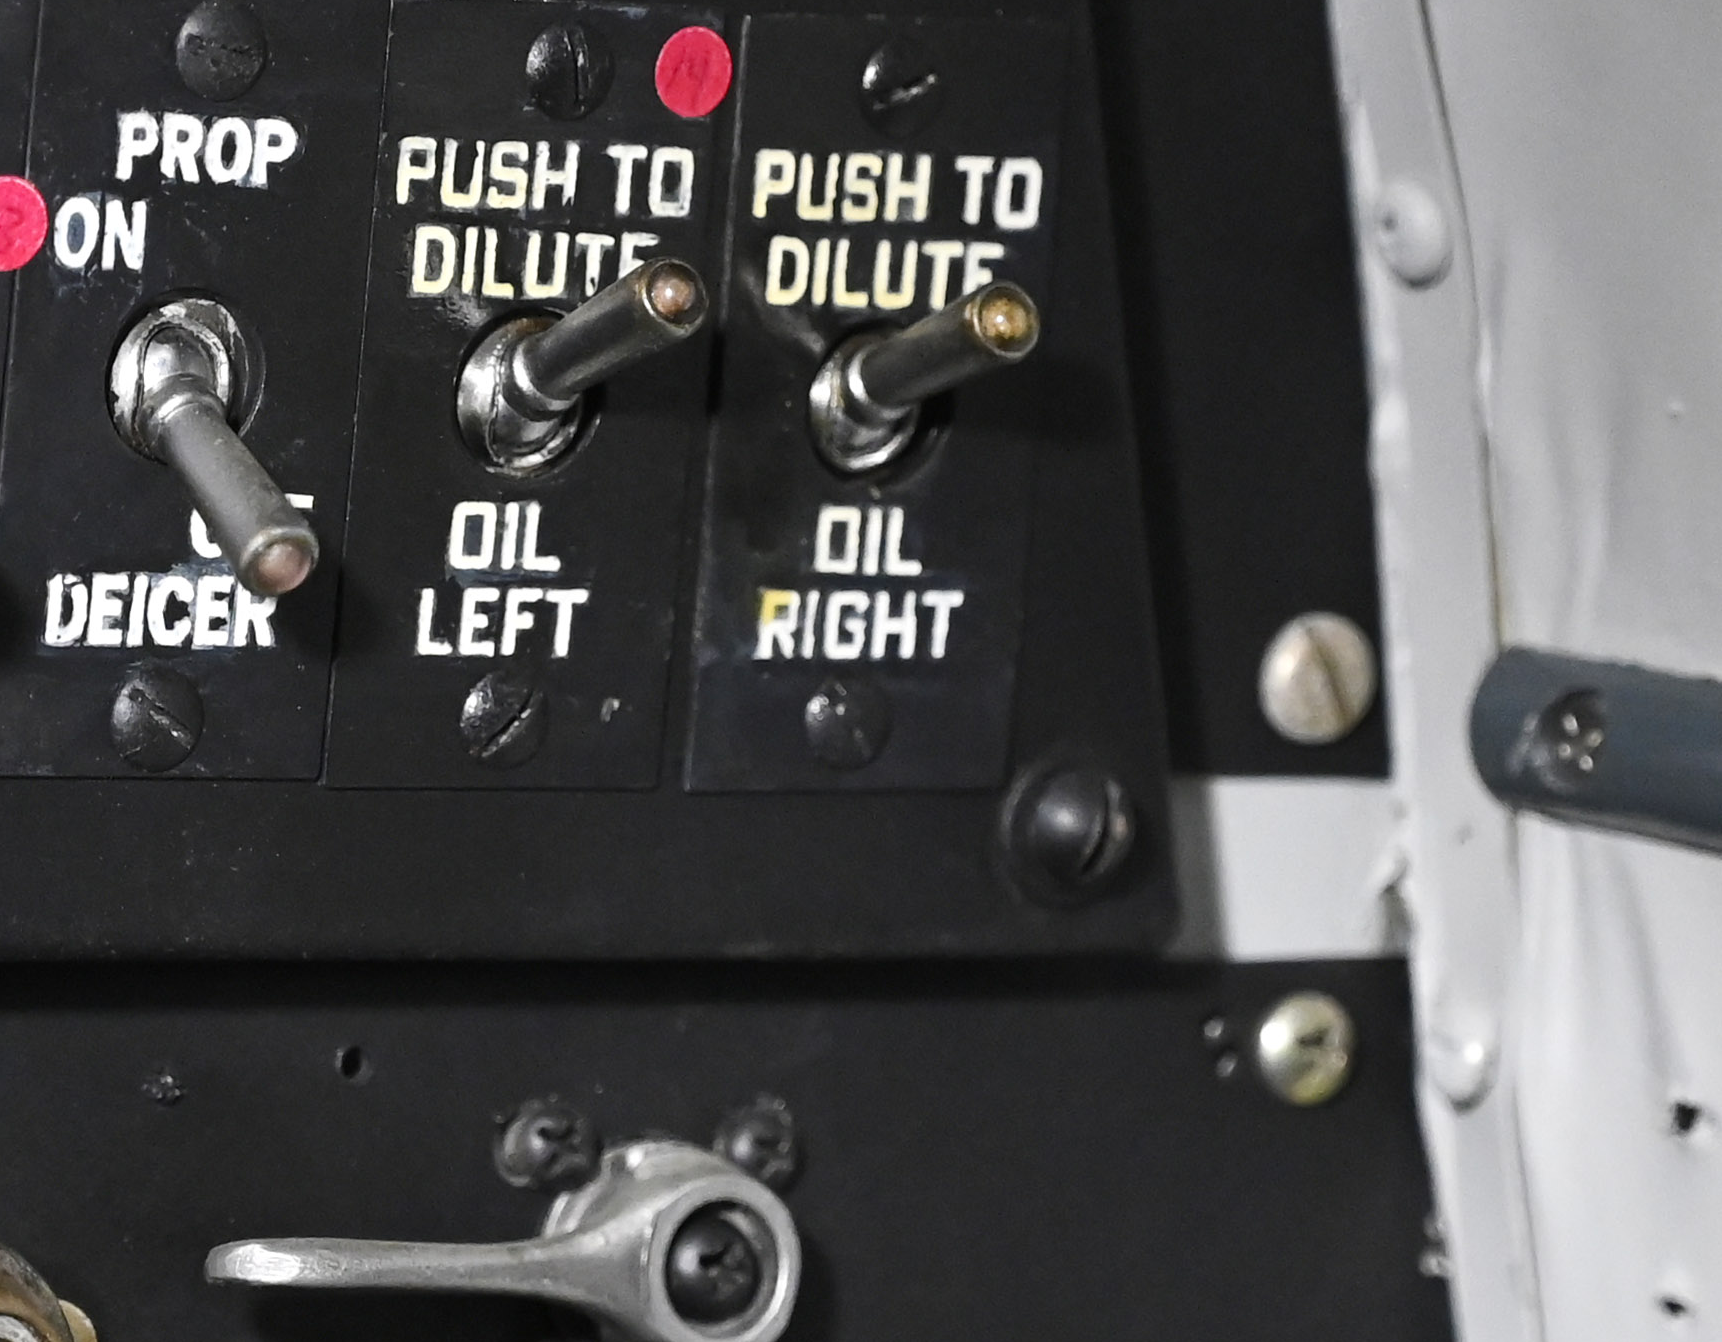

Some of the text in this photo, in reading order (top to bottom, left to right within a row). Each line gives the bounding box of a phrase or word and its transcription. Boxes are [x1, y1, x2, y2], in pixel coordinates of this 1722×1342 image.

[114, 110, 299, 188] PROP
[396, 135, 695, 218] PUSH TO
[753, 149, 1044, 231] PUSH TO
[54, 197, 149, 271] ON
[766, 236, 1005, 309] DILUTE
[449, 502, 562, 571] OIL
[815, 505, 923, 575] OIL
[43, 571, 277, 648] DEICER
[415, 588, 589, 658] LEFT
[756, 586, 964, 661] RIGHT
